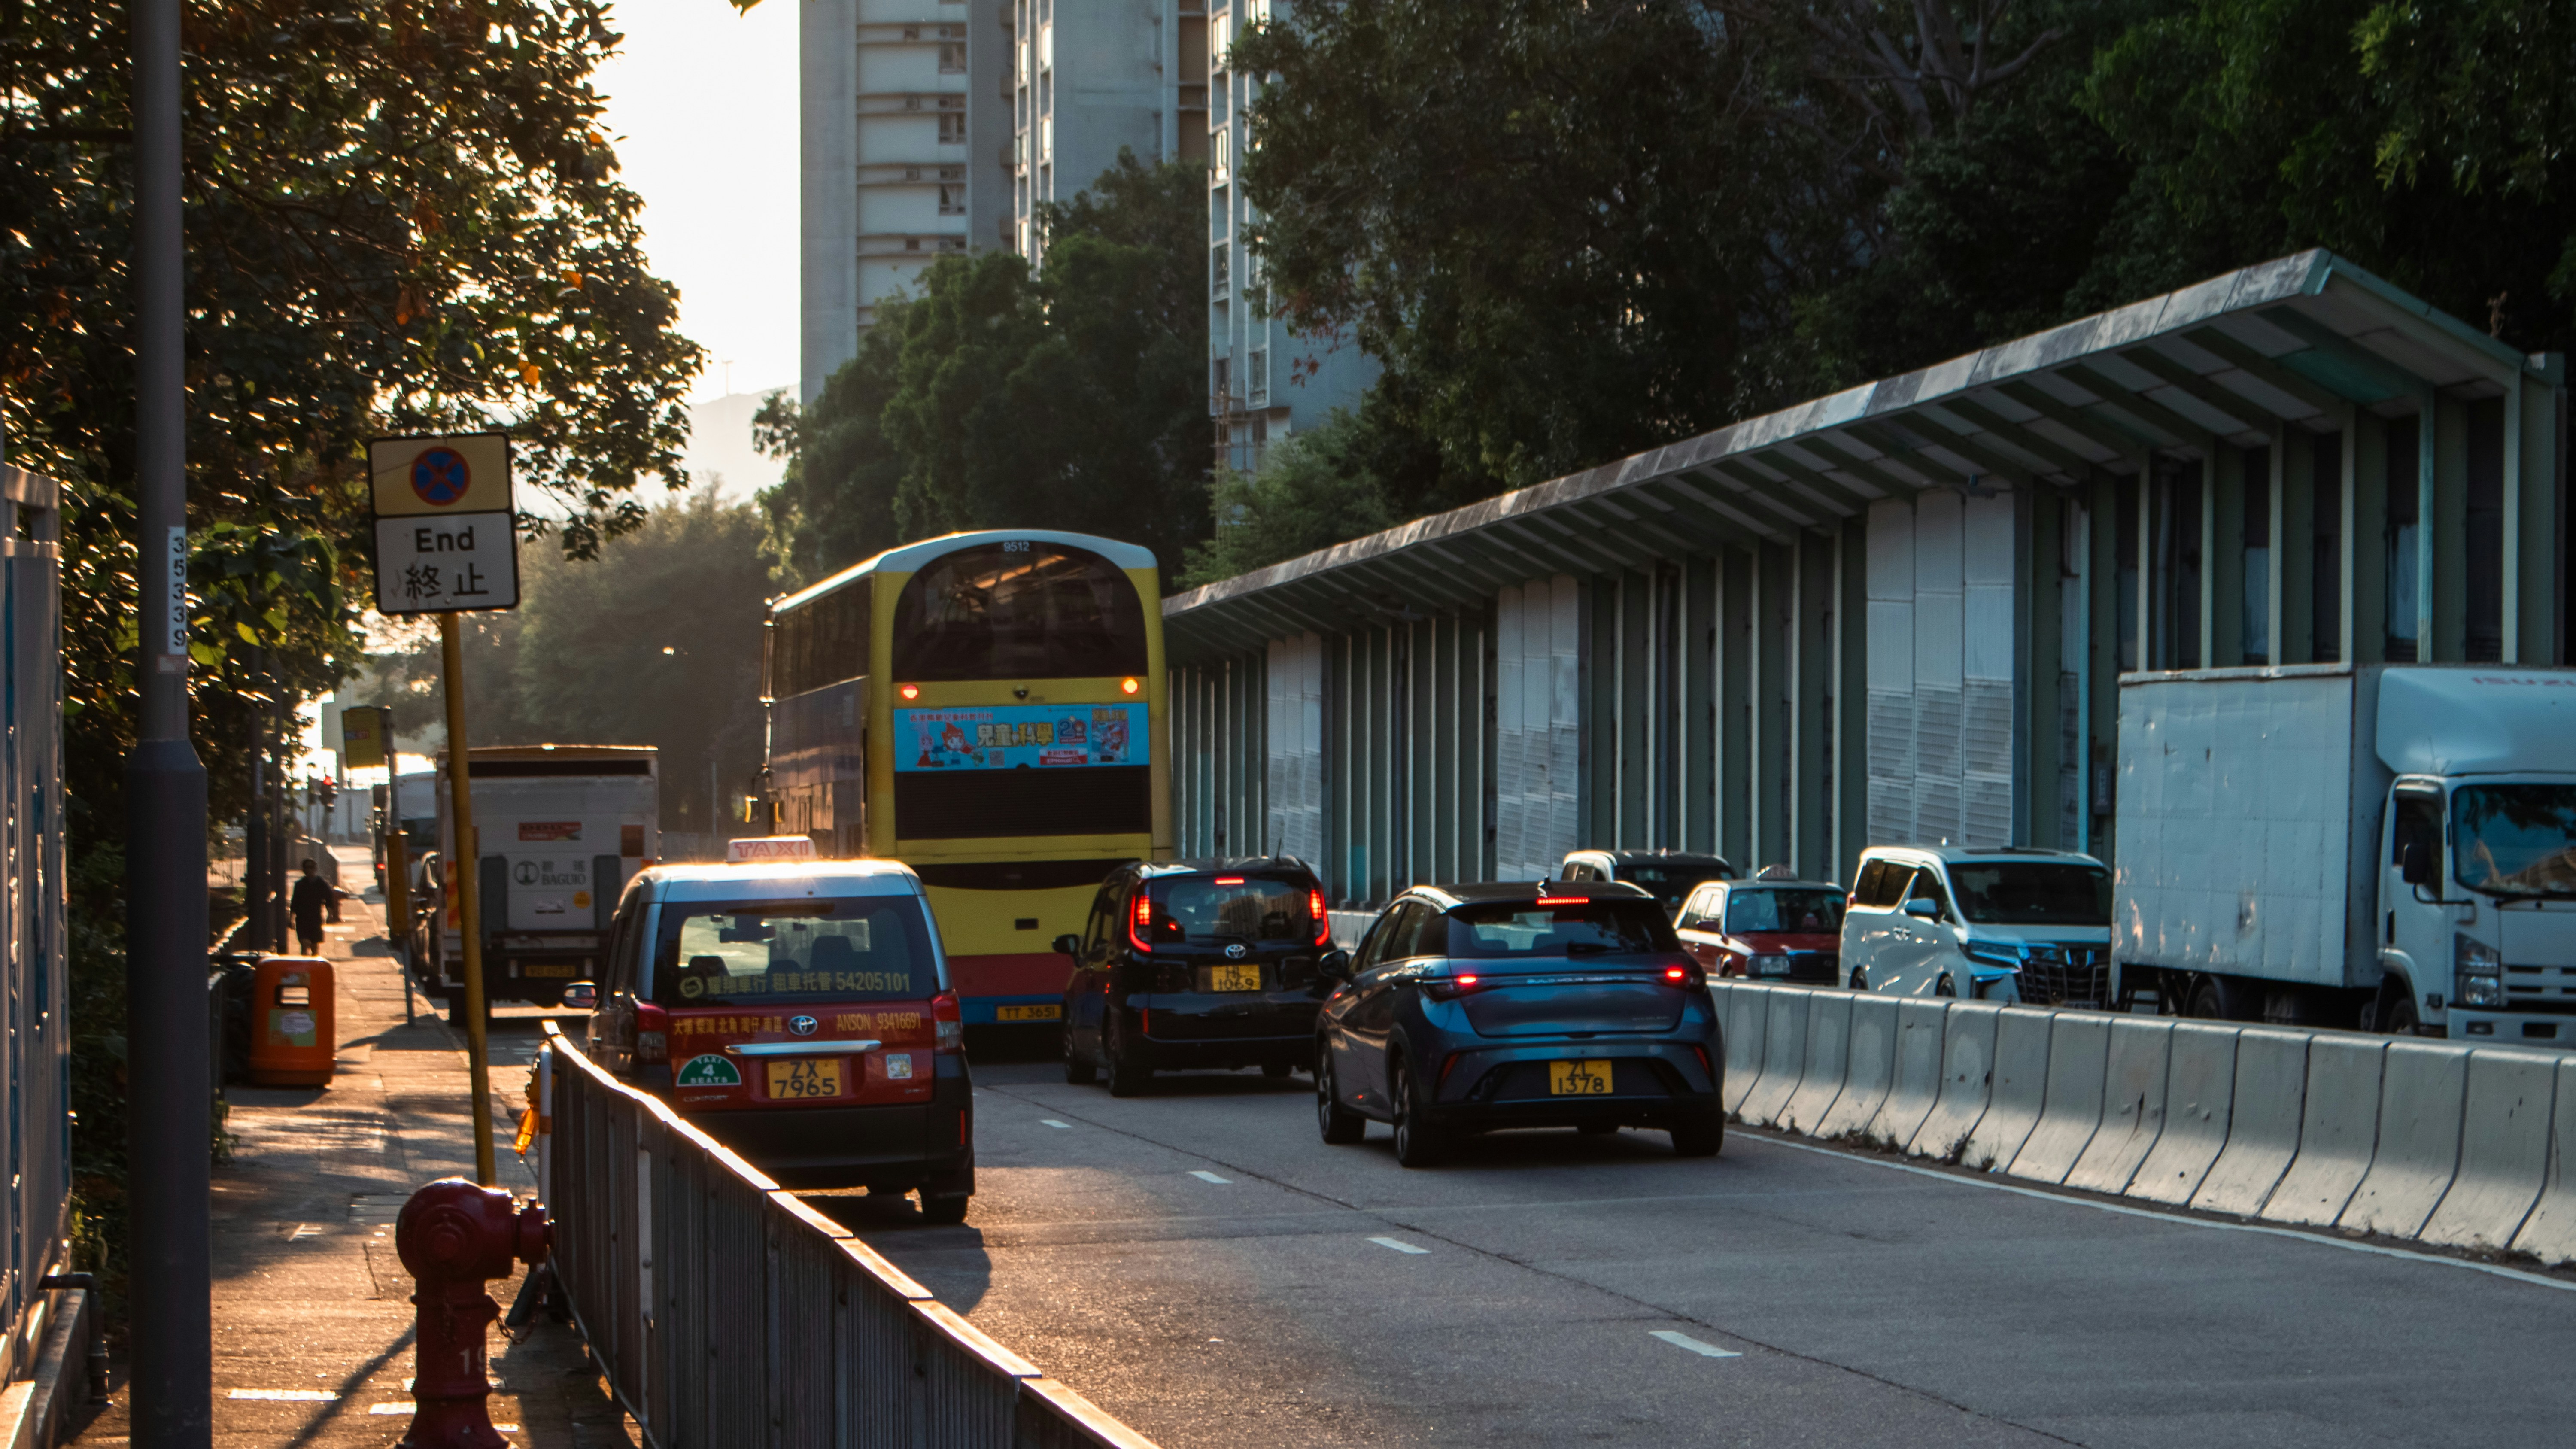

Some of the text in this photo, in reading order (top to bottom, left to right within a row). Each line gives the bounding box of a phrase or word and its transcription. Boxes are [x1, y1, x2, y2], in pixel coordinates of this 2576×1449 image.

[416, 526, 474, 553] End
[1004, 542, 1030, 552] 9512
[405, 562, 489, 600] 終止
[173, 537, 186, 647] 35339
[735, 841, 808, 858] TAXI
[542, 874, 586, 885] BAGUIO
[837, 972, 910, 992] 54205101
[1005, 1006, 1055, 1018] TT 3651
[837, 1012, 921, 1031] ANSON 93416691
[702, 1064, 714, 1076] 4
[790, 1061, 819, 1079] ZX
[1569, 1061, 1594, 1077] ZL
[774, 1078, 836, 1098] 7965
[1558, 1077, 1604, 1093] 1378
